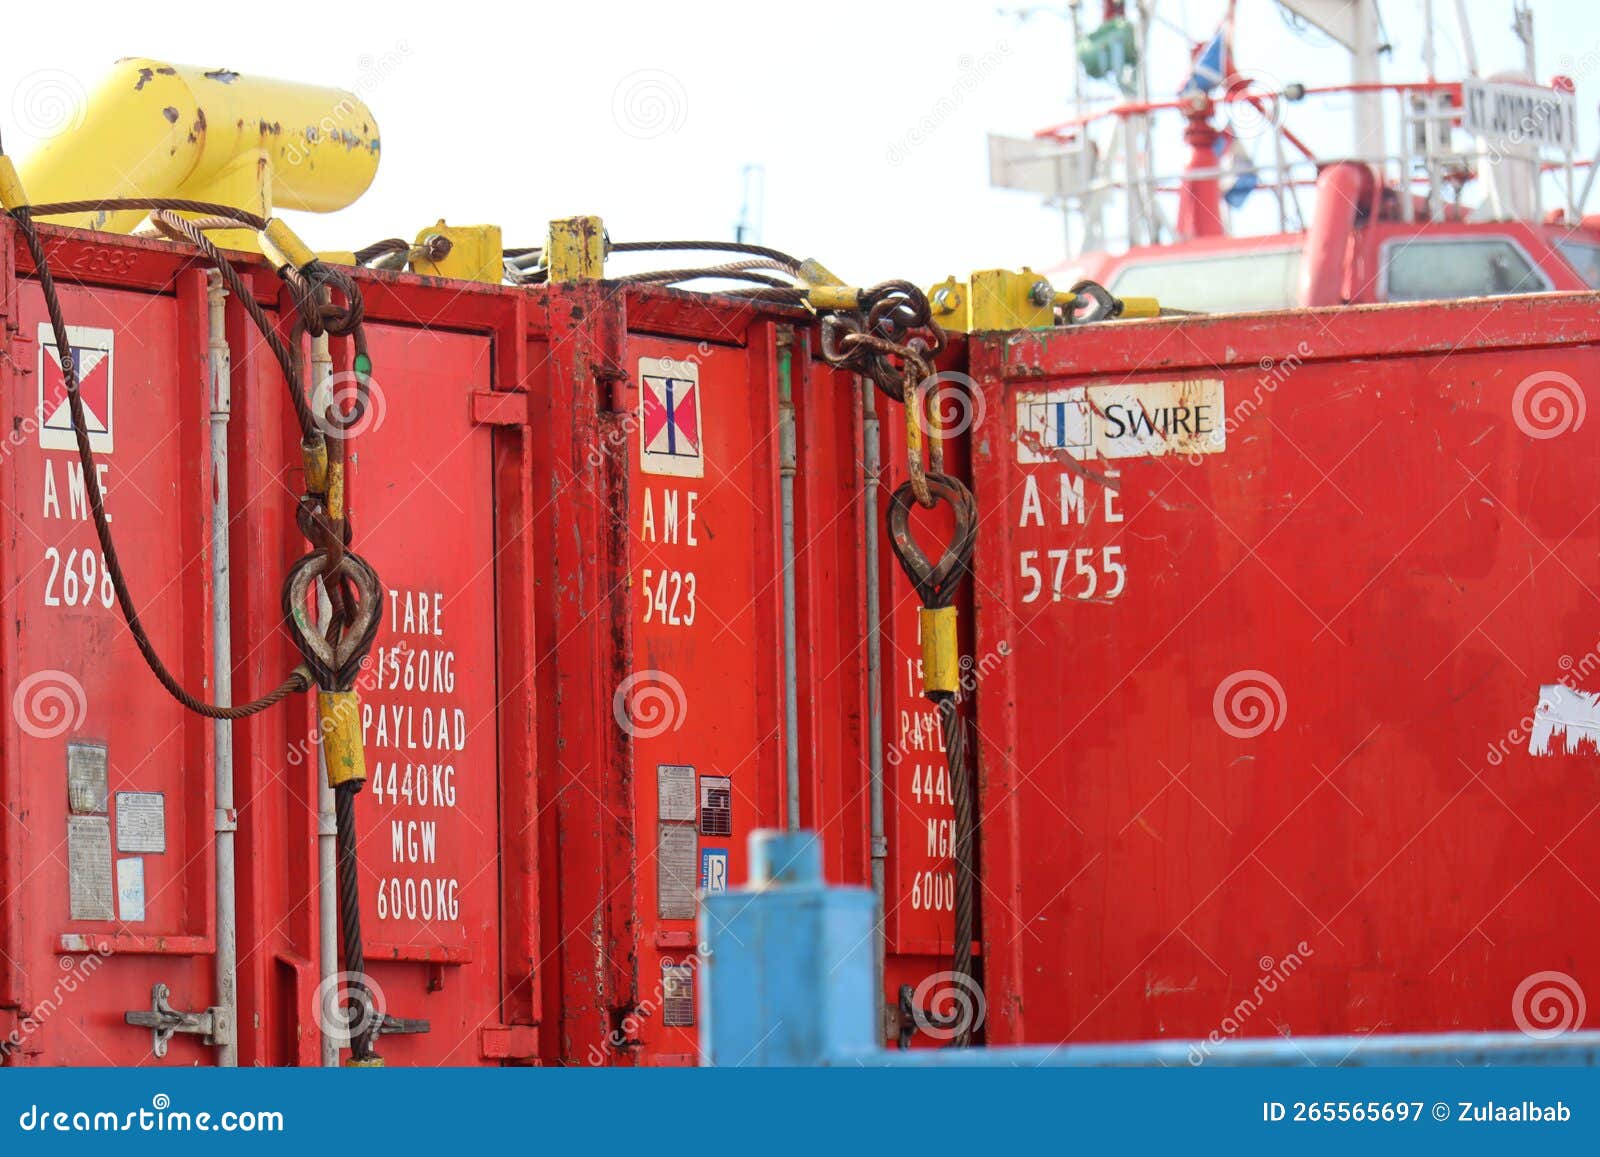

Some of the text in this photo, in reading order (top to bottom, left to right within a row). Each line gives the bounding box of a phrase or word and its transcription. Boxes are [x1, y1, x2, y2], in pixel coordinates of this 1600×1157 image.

[642, 569, 696, 626] 5423
[1020, 546, 1126, 603] 5755
[389, 590, 443, 636] TARE
[378, 647, 454, 694] 1560KG
[362, 704, 465, 750] PAYLOAD
[372, 762, 456, 807] 4440KG
[392, 820, 436, 864] MGW
[377, 878, 459, 921] 6000KG
